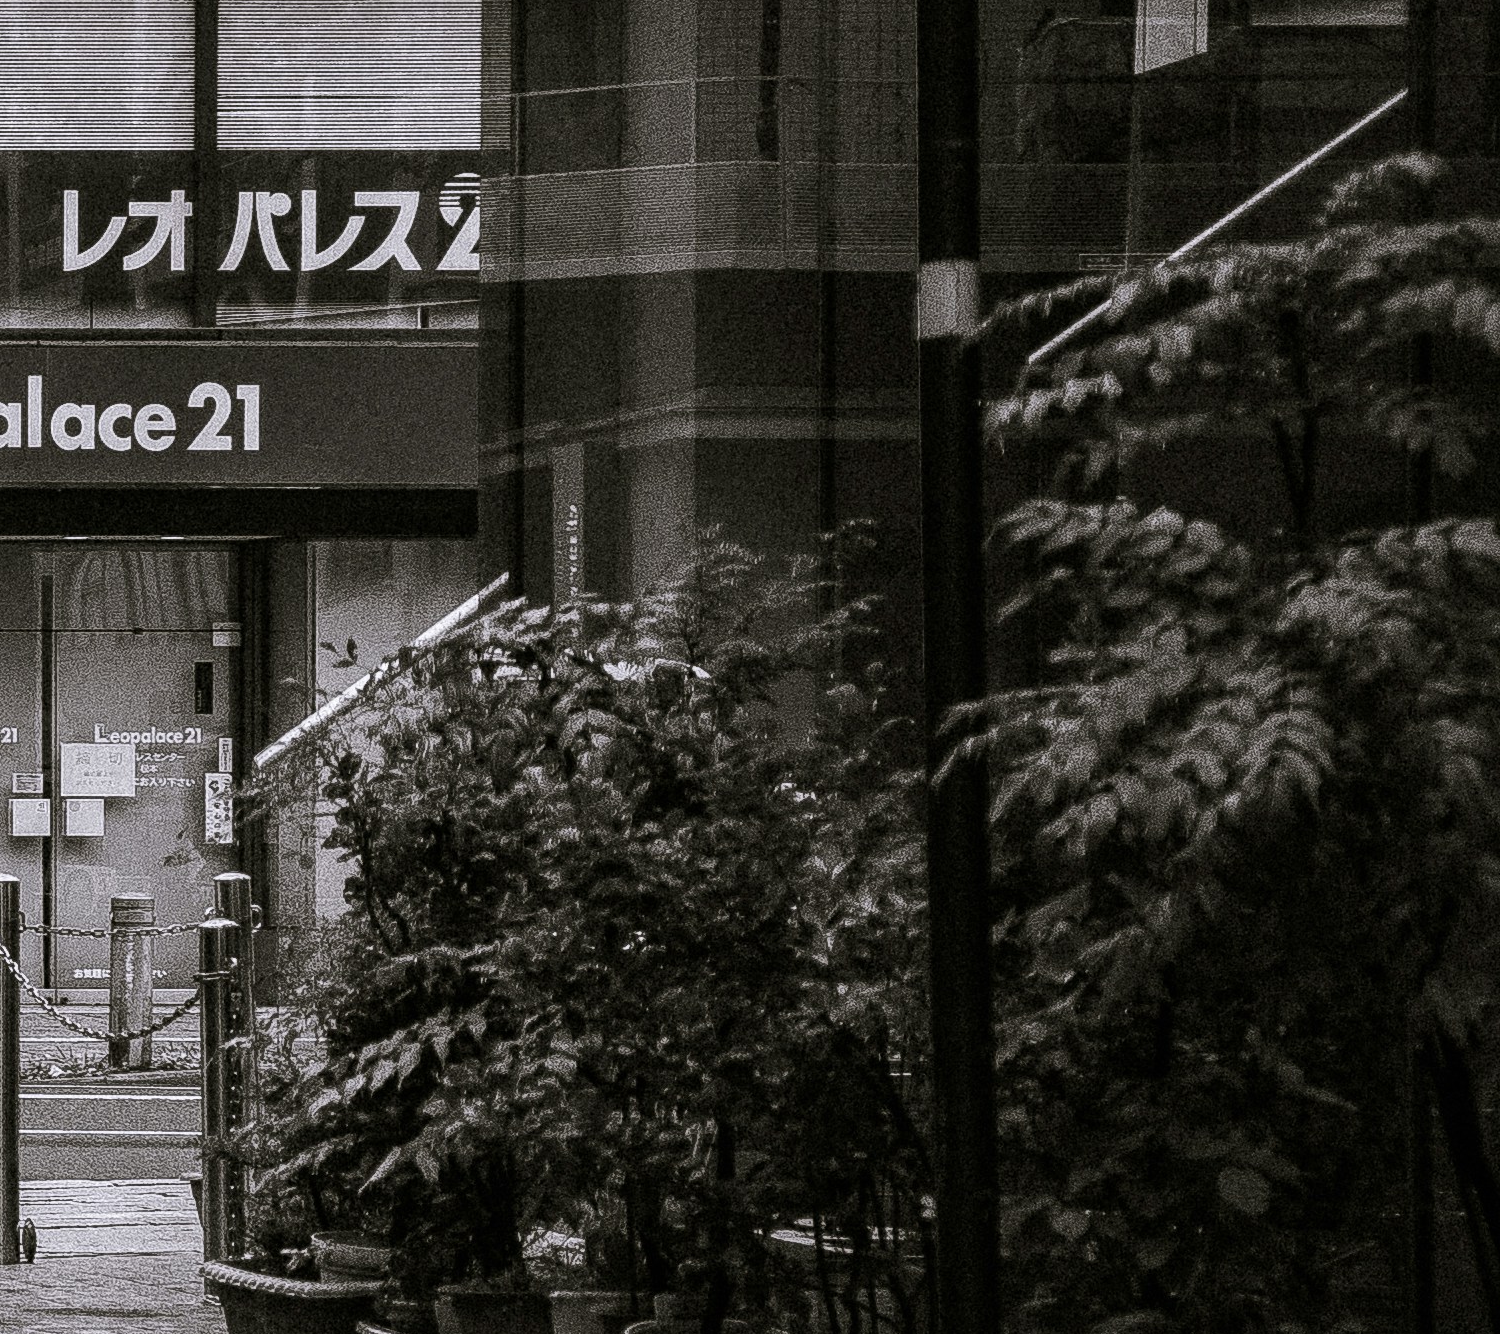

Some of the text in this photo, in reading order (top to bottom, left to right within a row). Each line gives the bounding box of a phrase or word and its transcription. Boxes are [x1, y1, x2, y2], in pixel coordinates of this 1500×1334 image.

[135, 752, 186, 762] レスセンター
[140, 763, 159, 774] 松本
